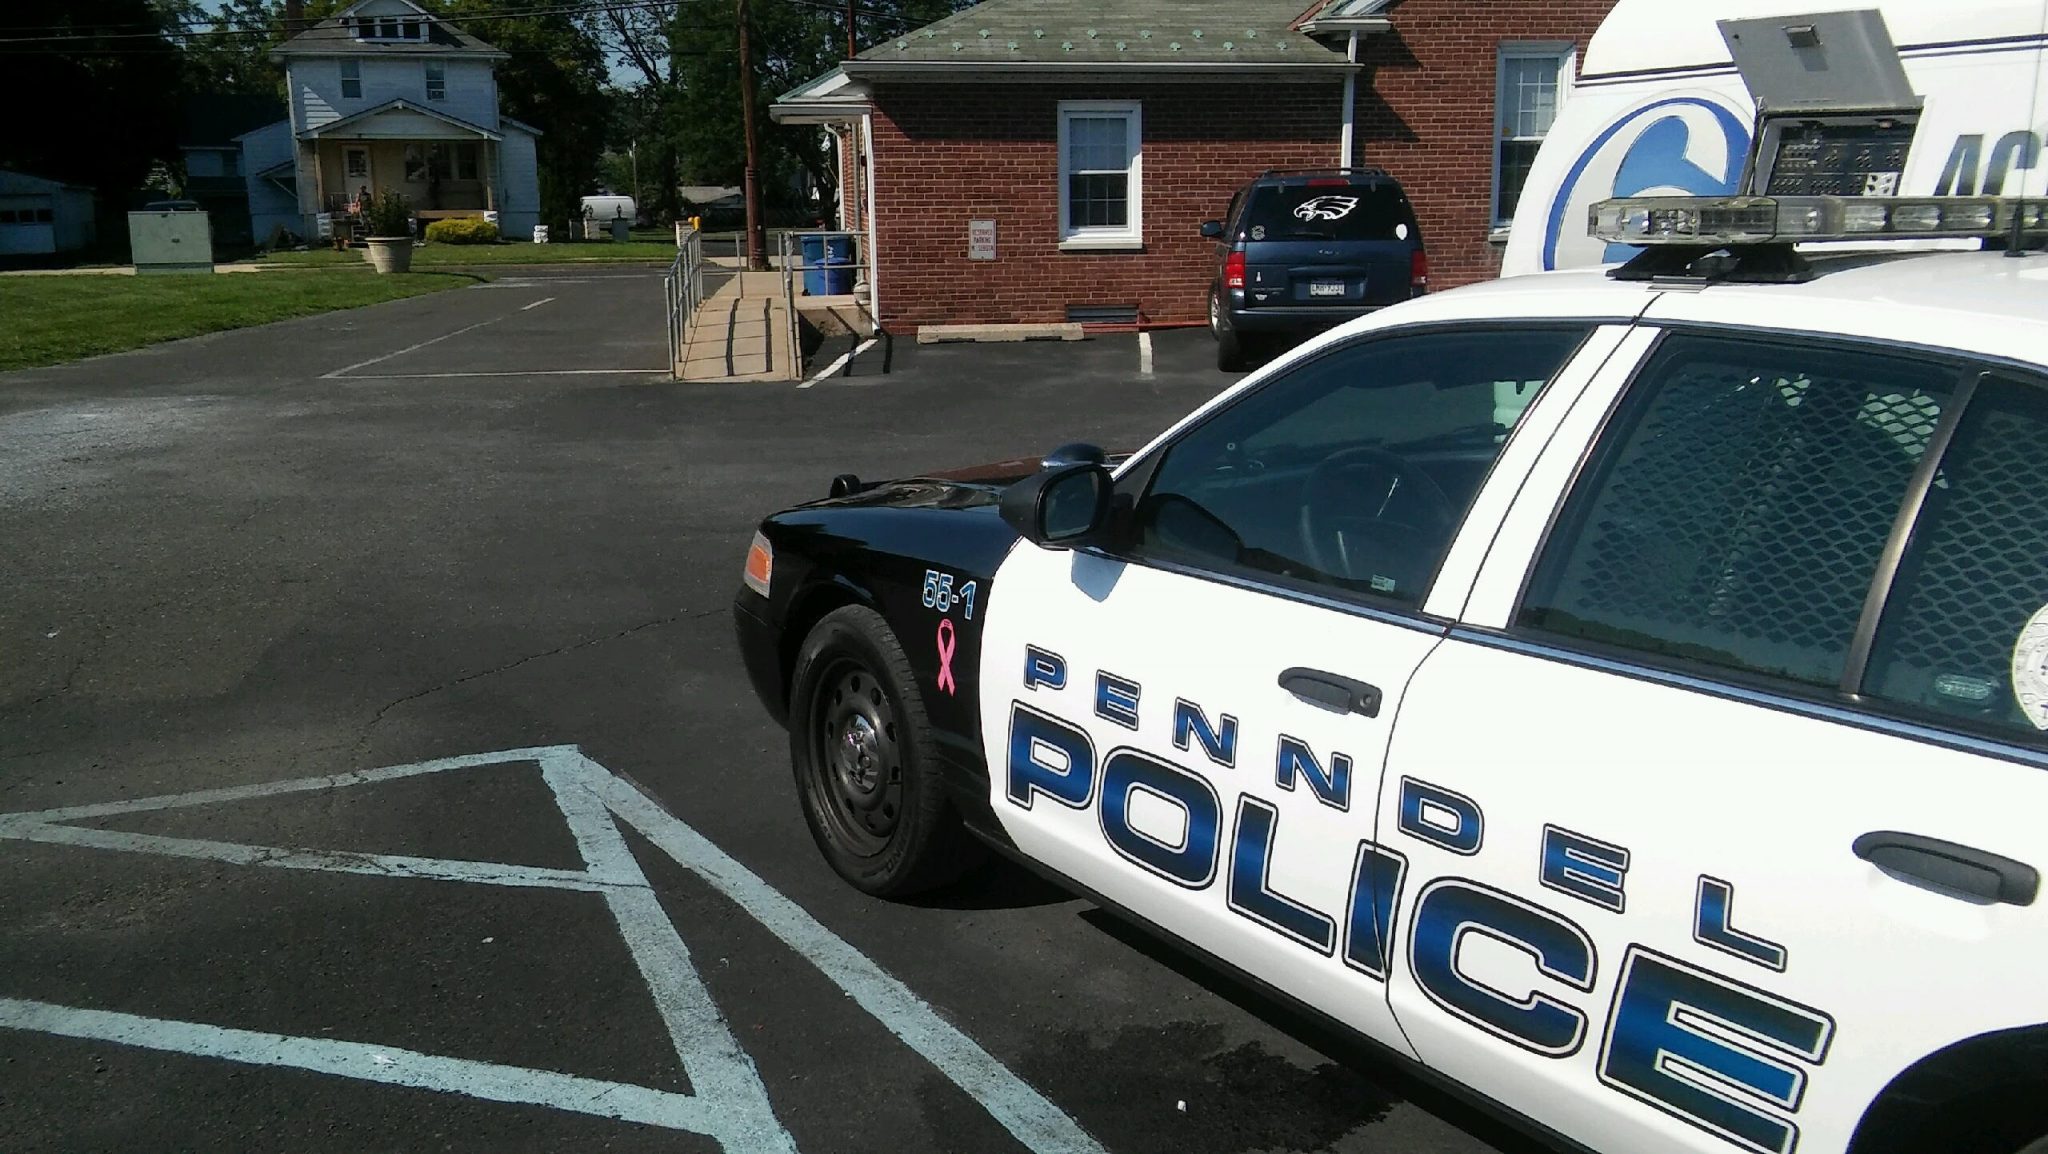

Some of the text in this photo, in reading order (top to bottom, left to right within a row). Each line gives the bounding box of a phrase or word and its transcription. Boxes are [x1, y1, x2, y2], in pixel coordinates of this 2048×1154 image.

[1933, 130, 2048, 196] AC
[922, 569, 977, 620] 55-1
[1024, 643, 1788, 974] PENNDEL
[1006, 698, 1837, 1154] POLICE
